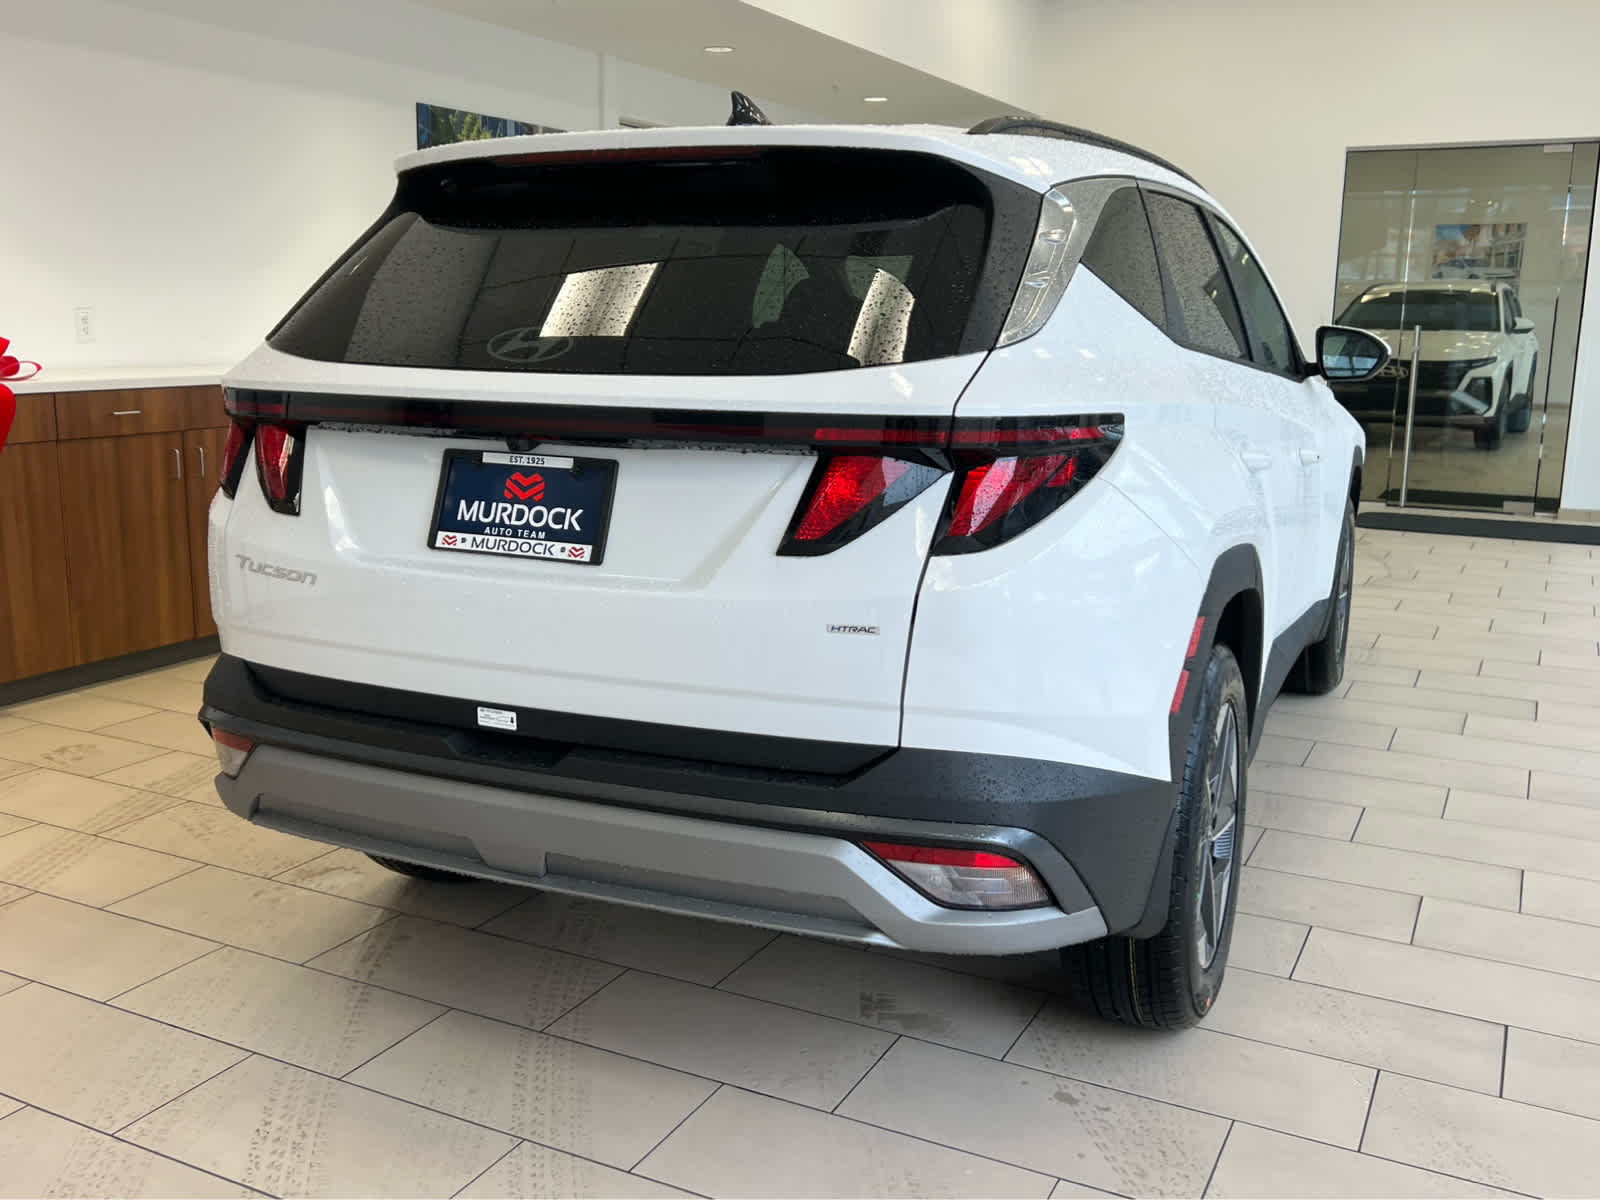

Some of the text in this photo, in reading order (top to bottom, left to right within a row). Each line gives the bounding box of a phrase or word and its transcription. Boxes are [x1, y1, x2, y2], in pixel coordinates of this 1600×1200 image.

[509, 455, 545, 465] EST. 1925
[457, 499, 584, 531] MURDOCK
[484, 526, 546, 540] AUTO TEAM
[471, 536, 556, 556] MURDOCK
[235, 553, 317, 585] Tucson
[829, 625, 878, 634] HTRAC
